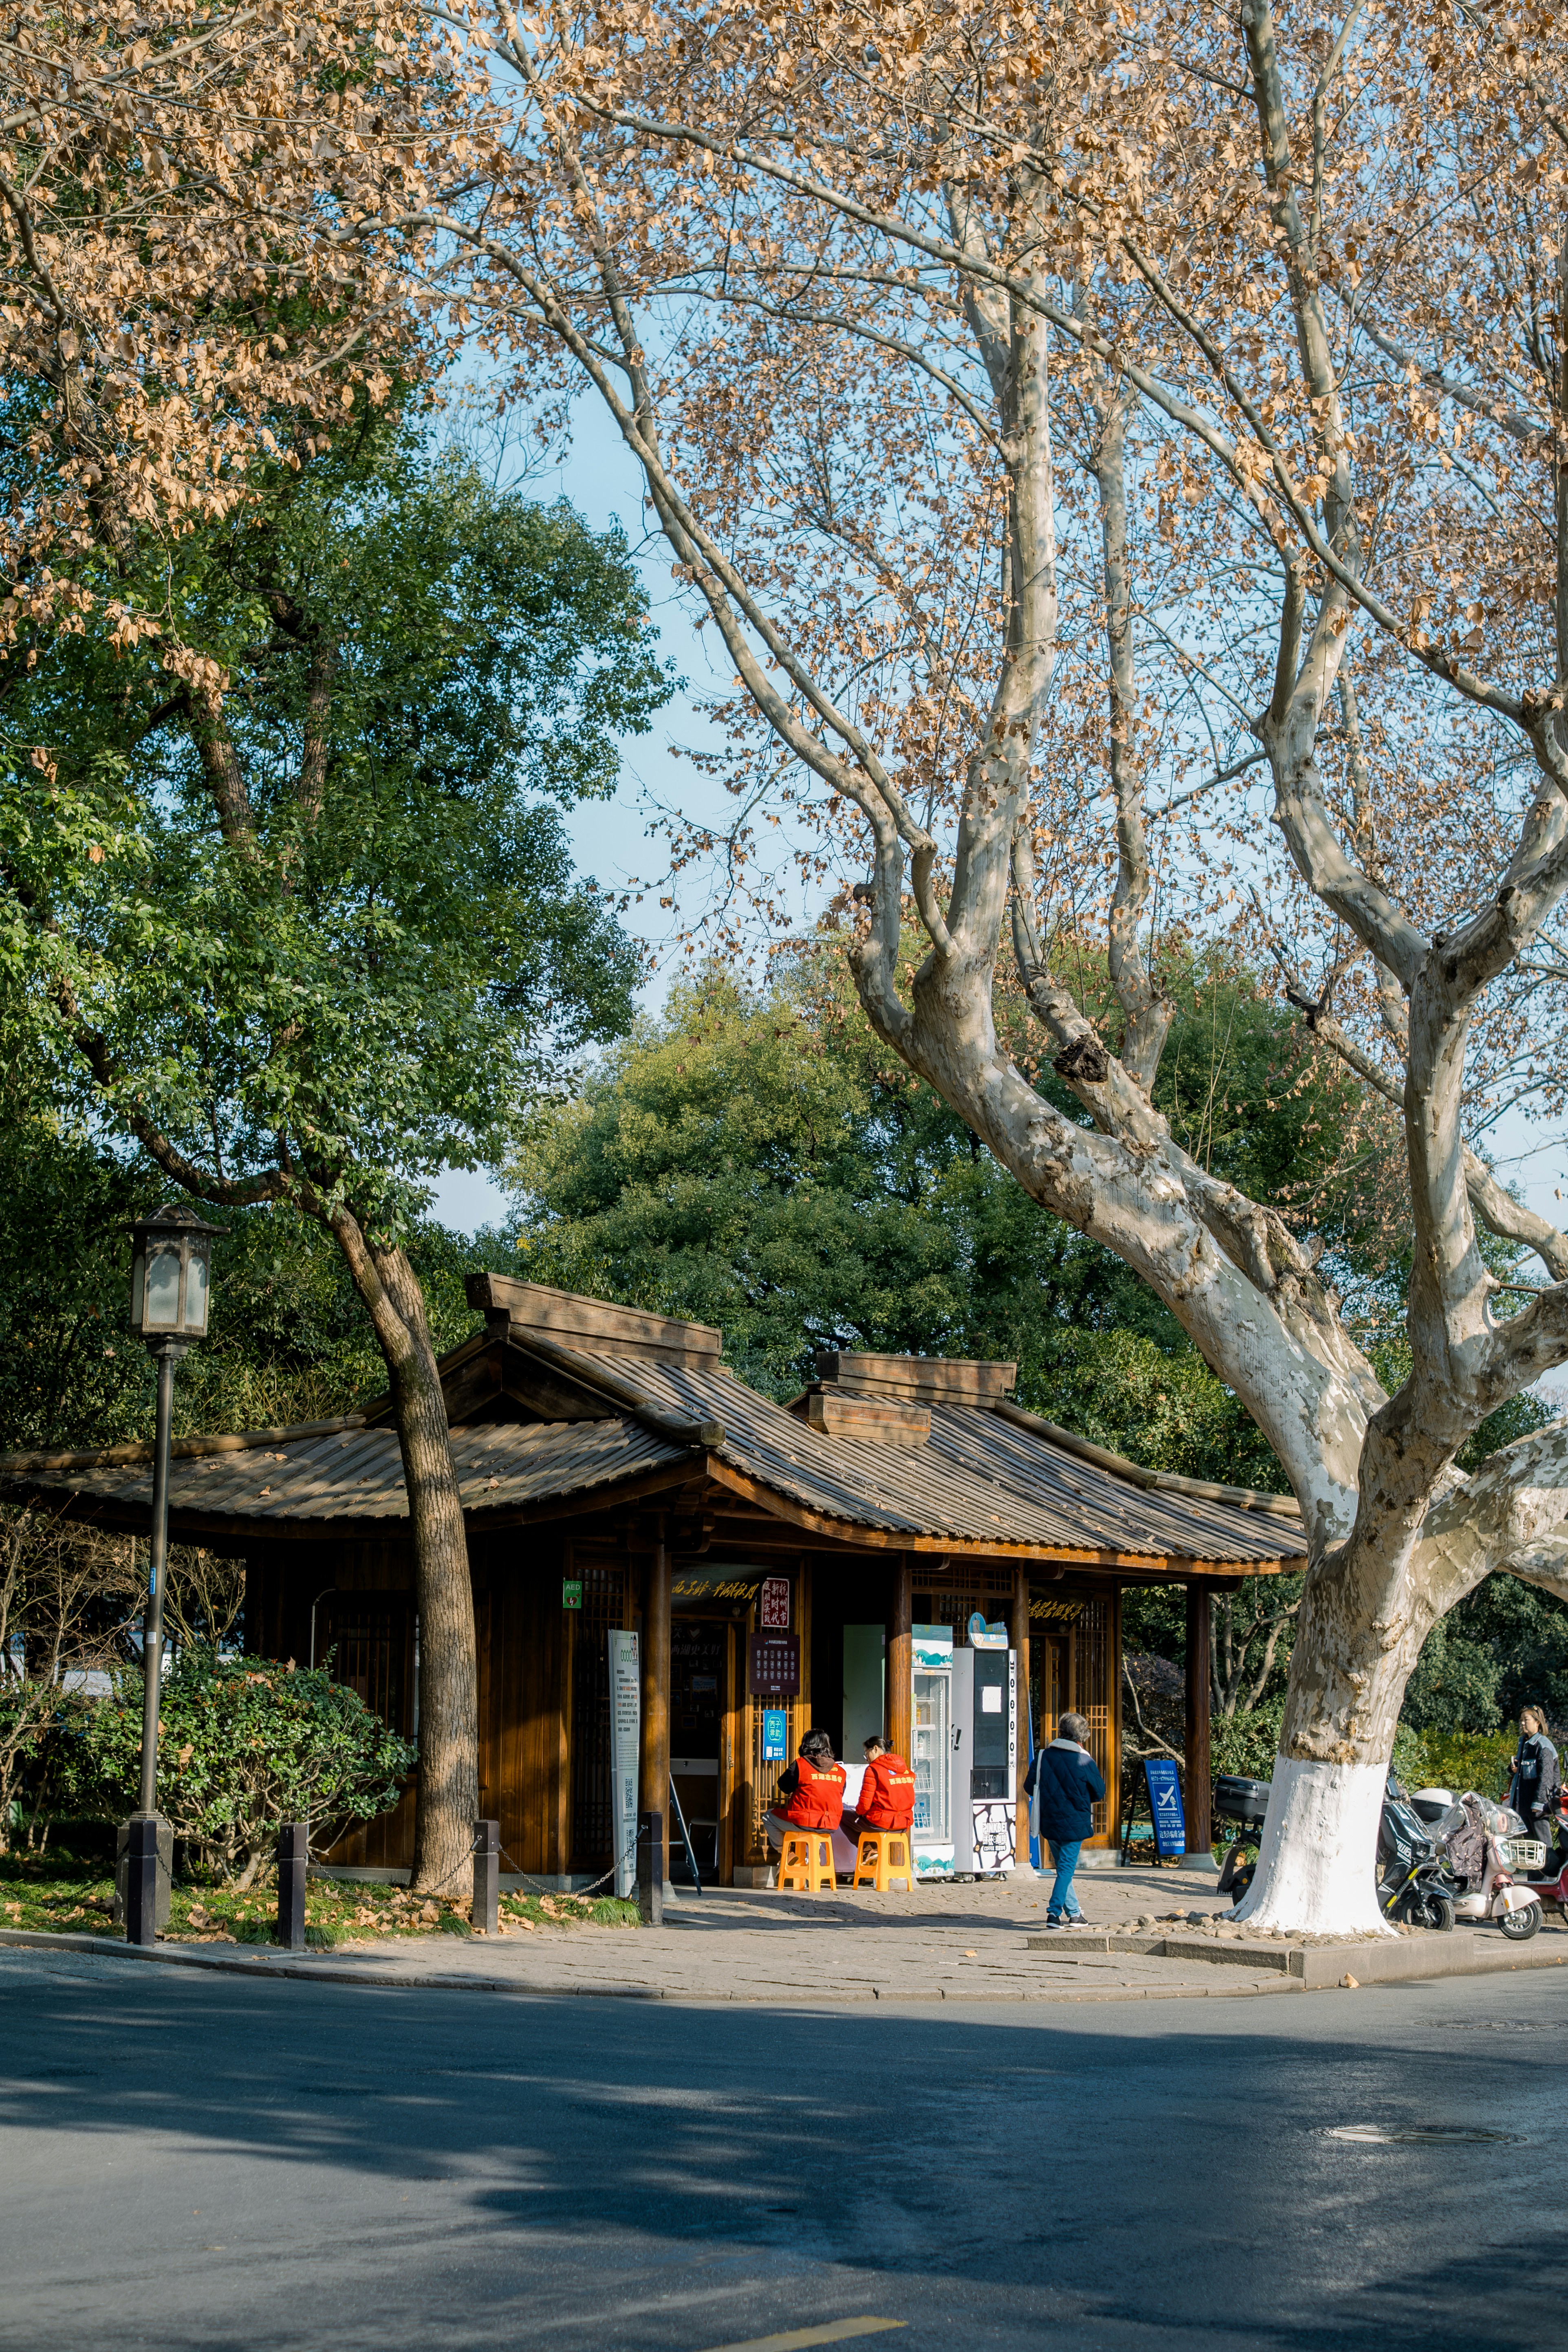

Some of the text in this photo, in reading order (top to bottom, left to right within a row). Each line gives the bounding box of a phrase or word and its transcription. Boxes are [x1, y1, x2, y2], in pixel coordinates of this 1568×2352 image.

[771, 1581, 780, 1625] 新时代
[779, 1583, 788, 1625] 杭州市
[770, 1720, 780, 1729] 西子
